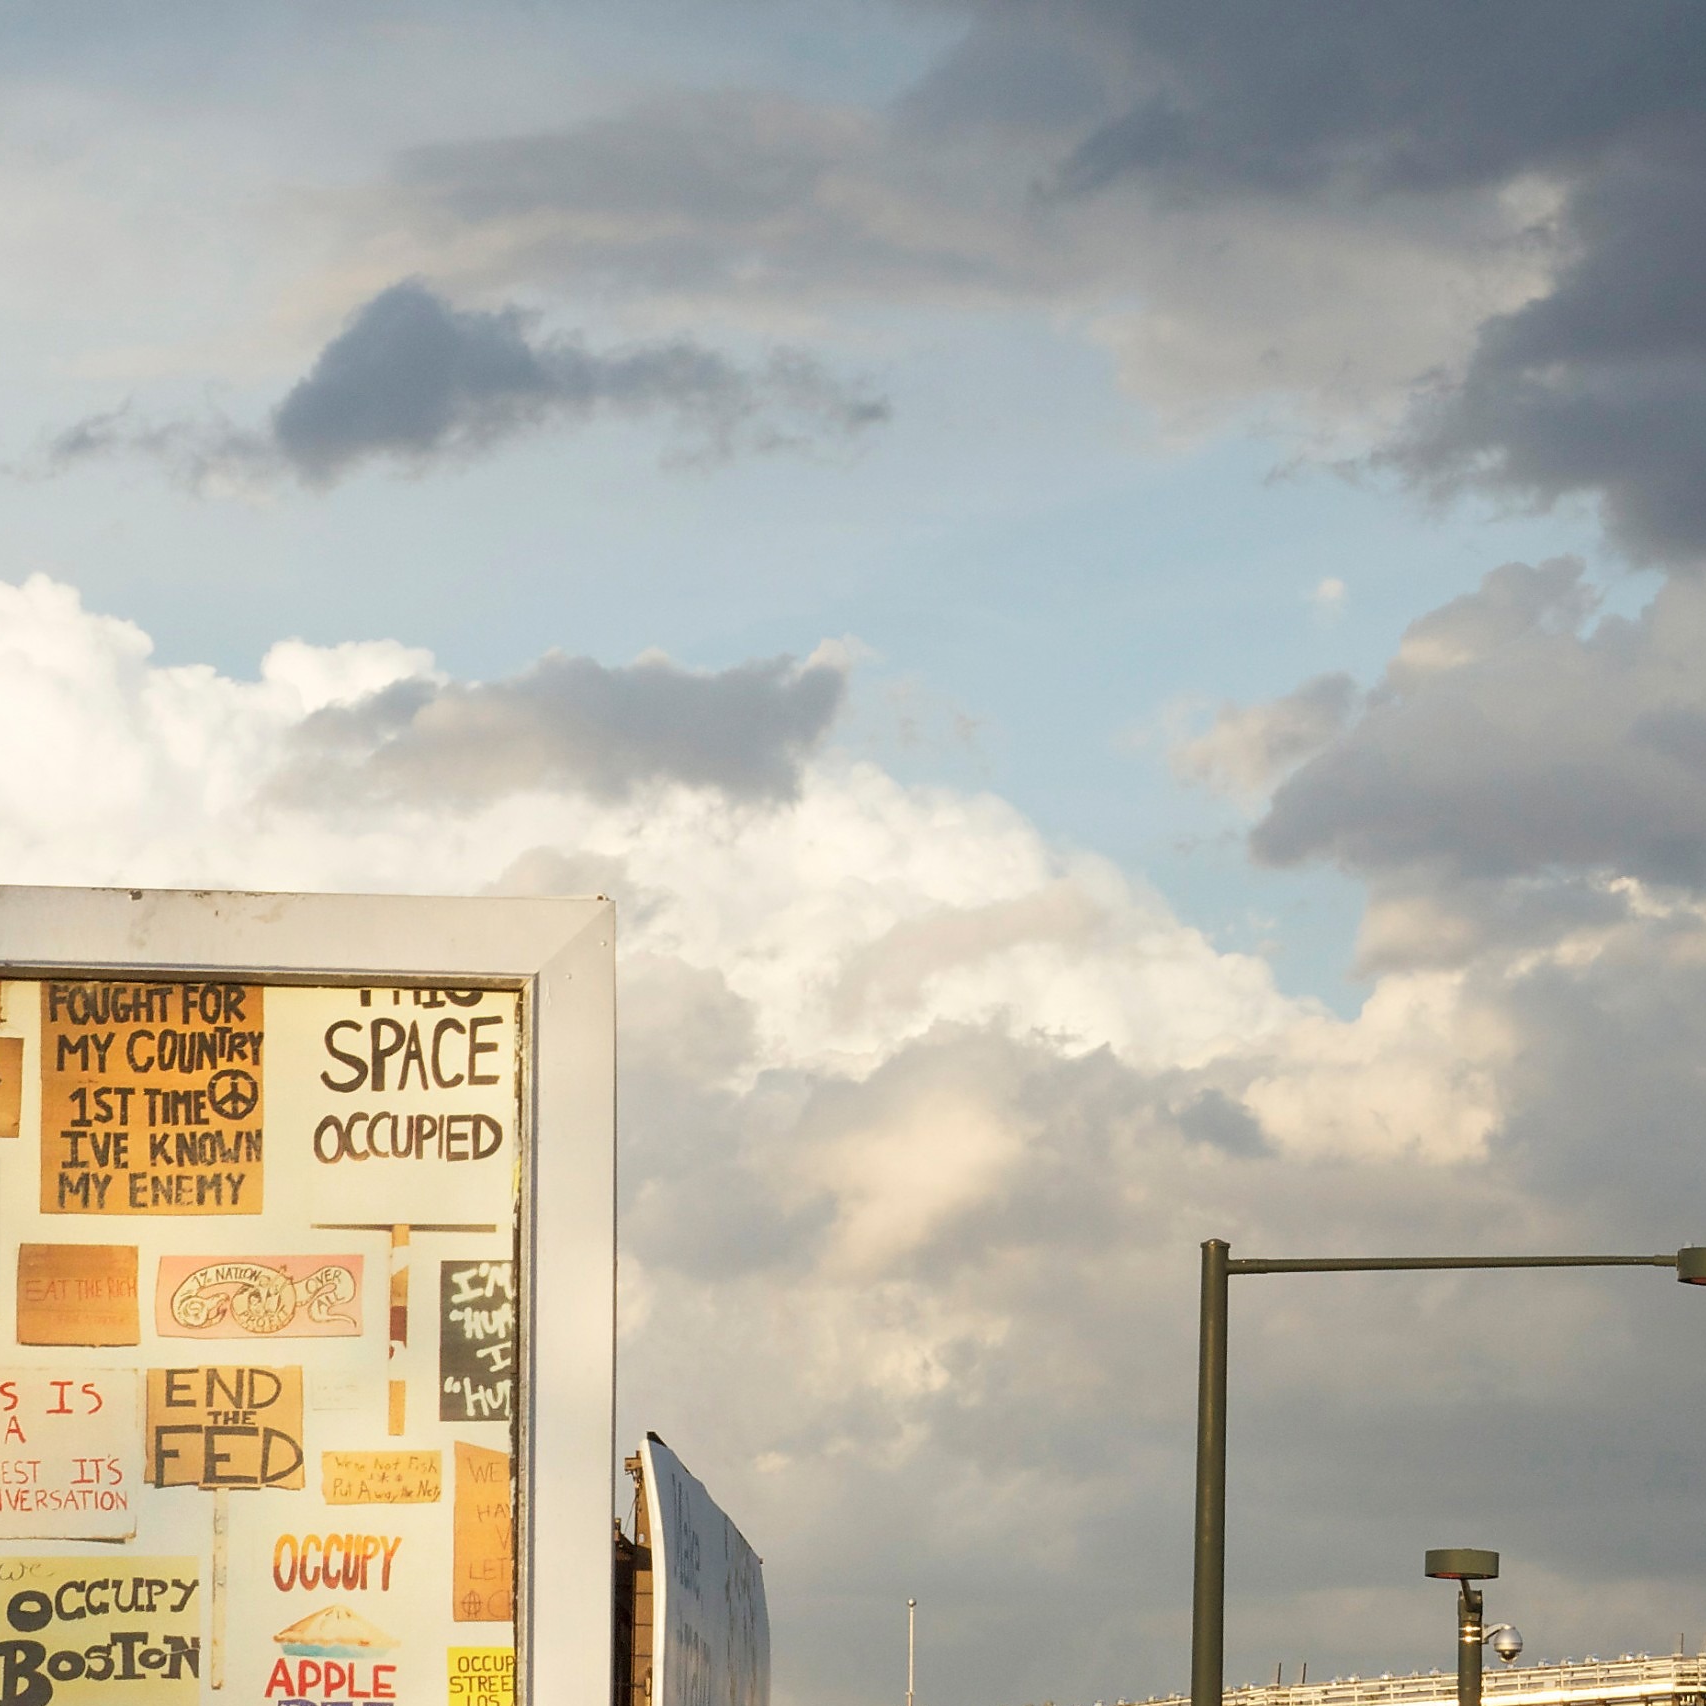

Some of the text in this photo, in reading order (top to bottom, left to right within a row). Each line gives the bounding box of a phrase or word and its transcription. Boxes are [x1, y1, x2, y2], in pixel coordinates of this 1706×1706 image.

[49, 984, 246, 1025] FOUGHT FOR
[56, 1026, 264, 1075] MY COUNTRY
[320, 1015, 504, 1093] SPACE
[68, 1086, 210, 1127] 1ST TIME
[60, 1129, 262, 1169] IVE KNOWN
[313, 1111, 504, 1164] OCCUPIED
[57, 1171, 246, 1210] MY ENEMY
[25, 1280, 68, 1301] EAT
[75, 1279, 102, 1299] THE
[47, 1381, 103, 1414] IS
[165, 1367, 282, 1409] END
[5, 1415, 27, 1444] A
[207, 1410, 257, 1425] THE
[71, 1453, 123, 1485] IT'S
[154, 1424, 304, 1489] FED
[273, 1534, 402, 1592] OCCUPY
[7, 1577, 199, 1632] OCCUPY
[264, 1657, 396, 1698] APPLE
